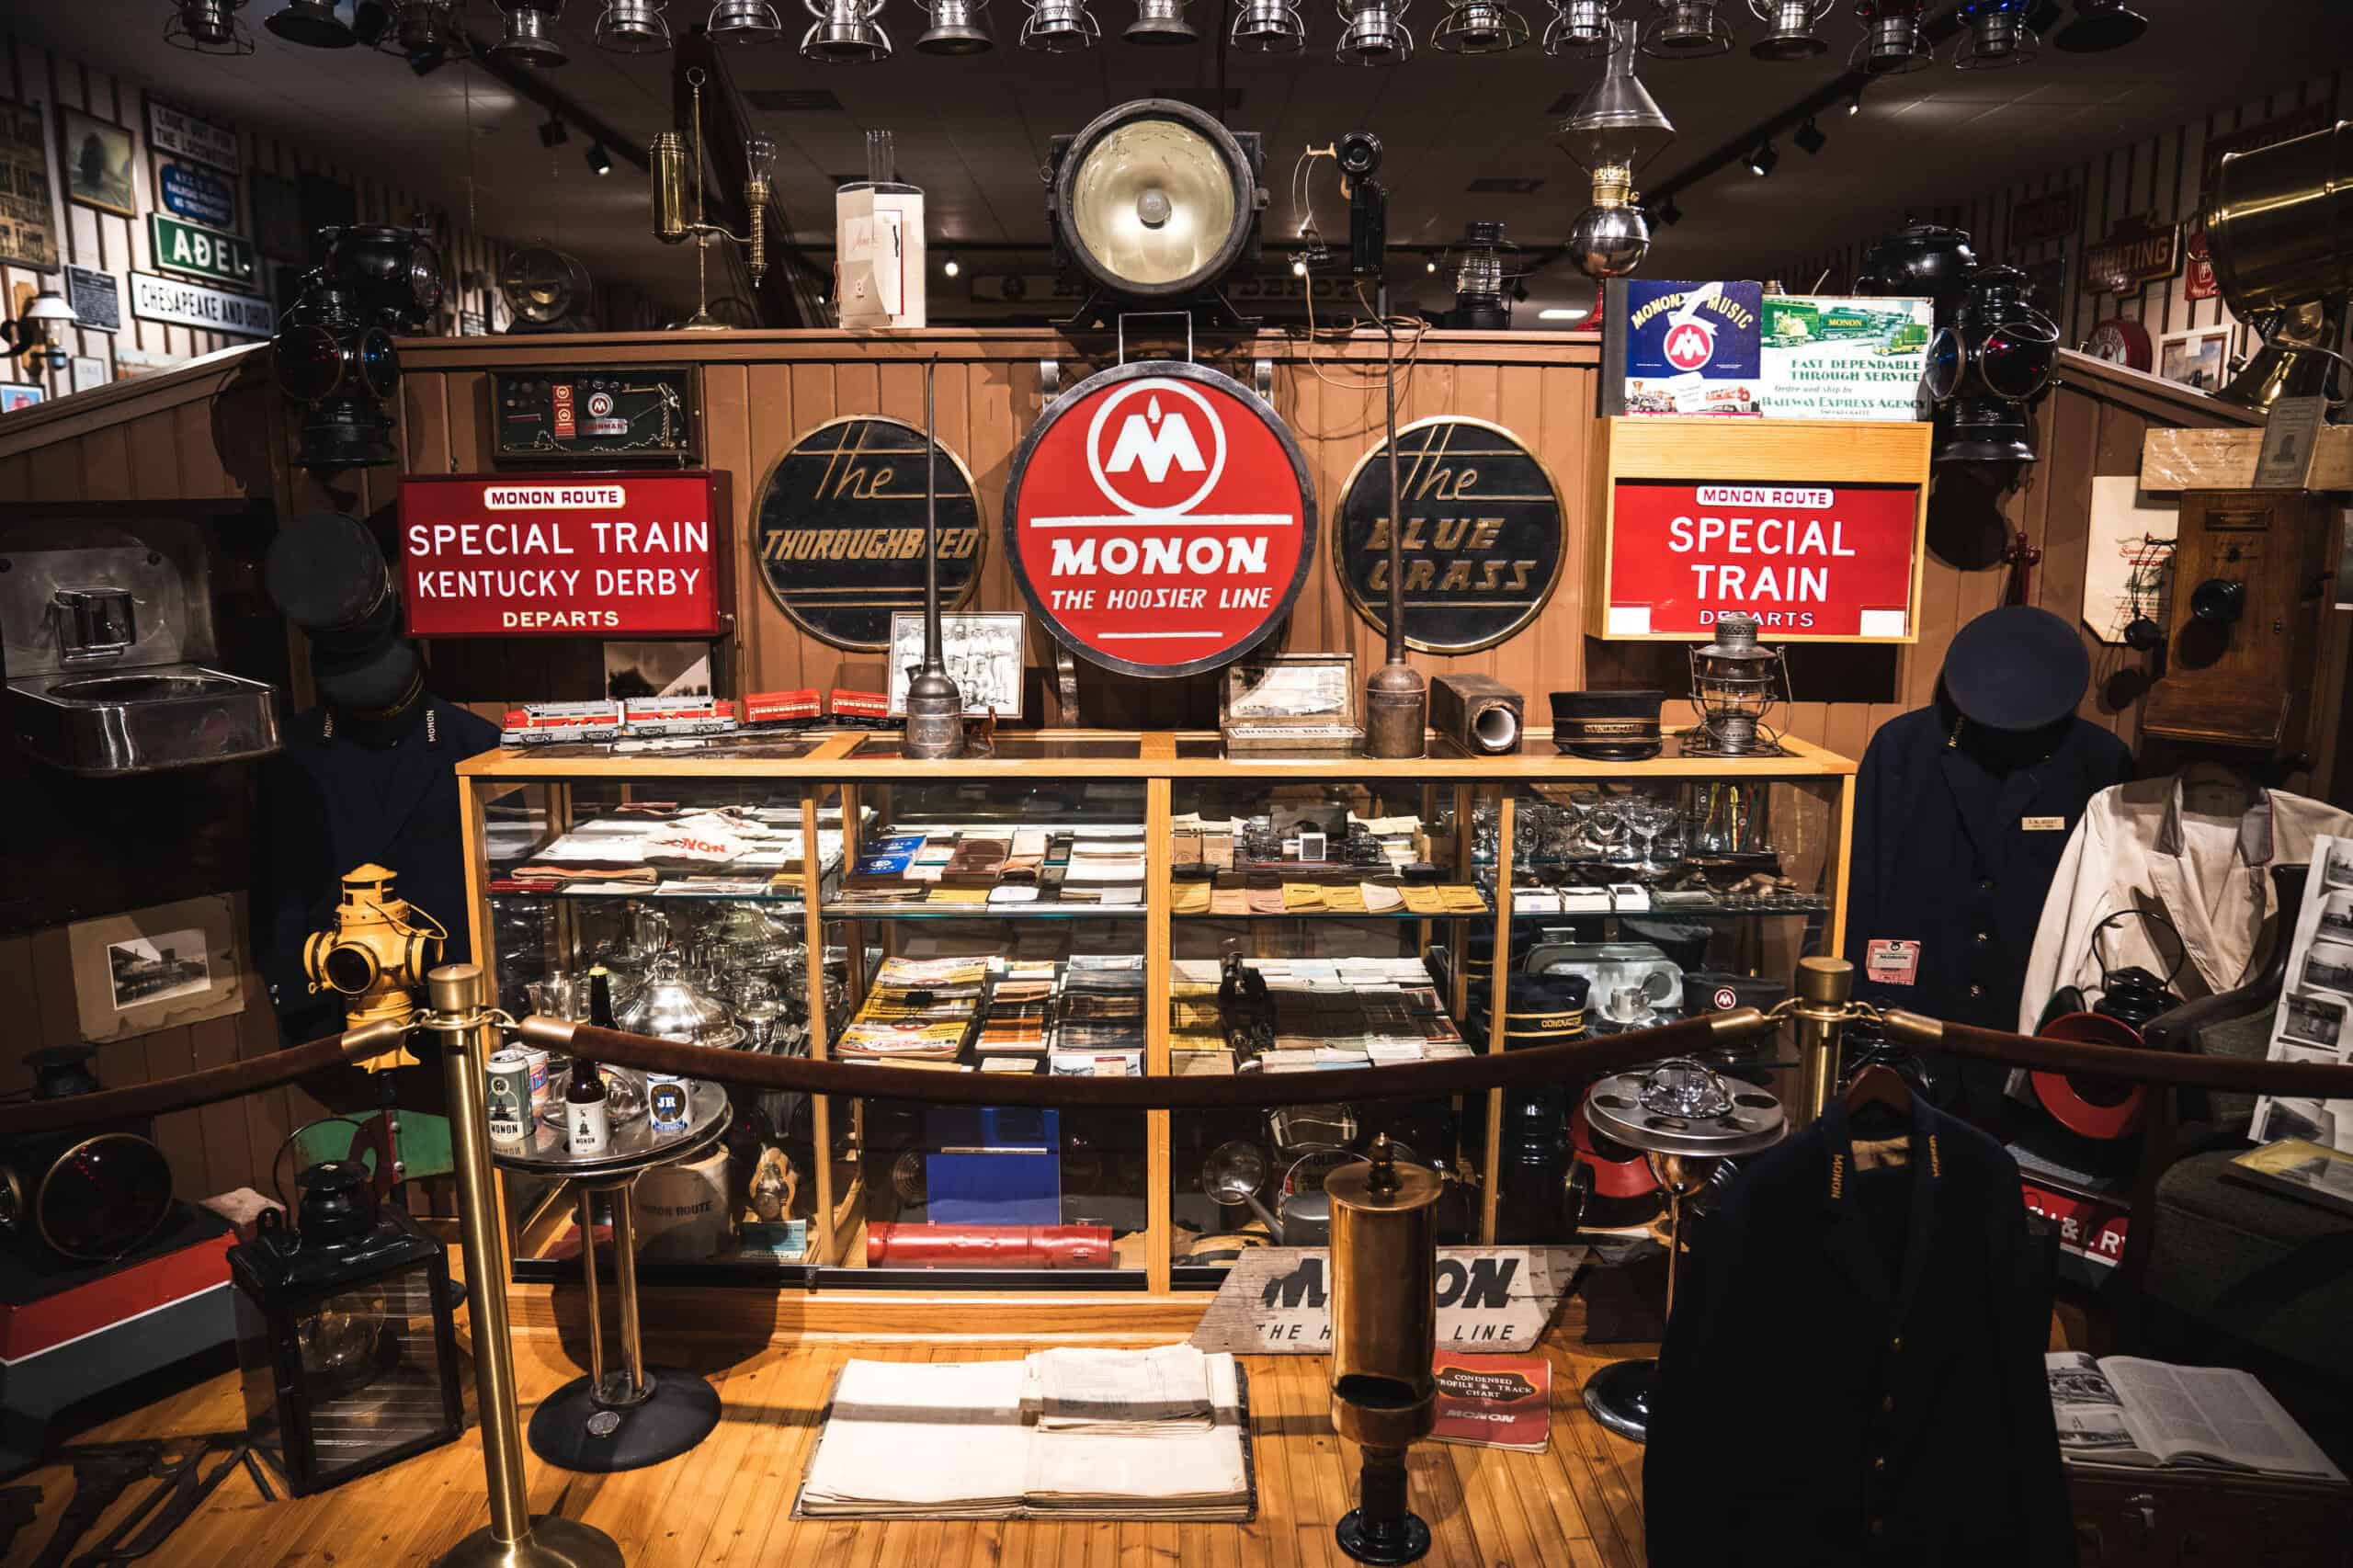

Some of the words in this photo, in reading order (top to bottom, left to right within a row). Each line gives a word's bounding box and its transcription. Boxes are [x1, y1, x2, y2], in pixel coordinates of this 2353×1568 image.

[172, 228, 247, 276] ADEL
[142, 283, 219, 322] CHESAPEAKE
[222, 299, 243, 324] AND
[1631, 293, 1682, 330] MONON
[1706, 294, 1754, 329] MUSIC
[1828, 317, 1862, 326] MONON
[1792, 358, 1824, 369] FAST
[1831, 358, 1920, 370] DEPENDABLE
[1790, 370, 1859, 381] THROUGH
[1864, 371, 1920, 382] SERVICE
[1761, 396, 1816, 408] RAILWAY
[1819, 396, 1875, 408] EXPRESS
[1877, 398, 1927, 409] AGENCY
[814, 421, 895, 500] The
[1400, 424, 1479, 501] The
[492, 491, 554, 505] MONON
[562, 490, 619, 505] ROUTE
[1703, 489, 1765, 503] MONON
[1772, 491, 1827, 505] ROUTE
[409, 523, 574, 556] SPECIAL
[591, 521, 709, 553] TRAIN
[1365, 517, 1507, 551] BLUE
[1667, 516, 1857, 557] SPECIAL
[1051, 536, 1268, 576] MONON
[418, 570, 581, 598] KENTUCKY
[596, 568, 700, 597] DERBY
[1690, 563, 1829, 603] TRAIN
[1051, 590, 1097, 610] THE
[1107, 588, 1208, 610] HOOSIER
[1219, 587, 1273, 609] LINE
[503, 610, 620, 628] DEPARTS
[657, 1096, 676, 1108] JR
[491, 1123, 518, 1135] MONON
[1830, 1153, 1847, 1199] MONON
[676, 1200, 713, 1217] ROUTE
[1256, 1324, 1302, 1341] THE
[1453, 1324, 1516, 1341] LINE
[1439, 1378, 1474, 1390] ROFILE
[1498, 1384, 1533, 1394] TRACK
[1455, 1374, 1513, 1386] CONDENSED
[1466, 1389, 1501, 1398] CHART
[1446, 1409, 1516, 1424] MONON
